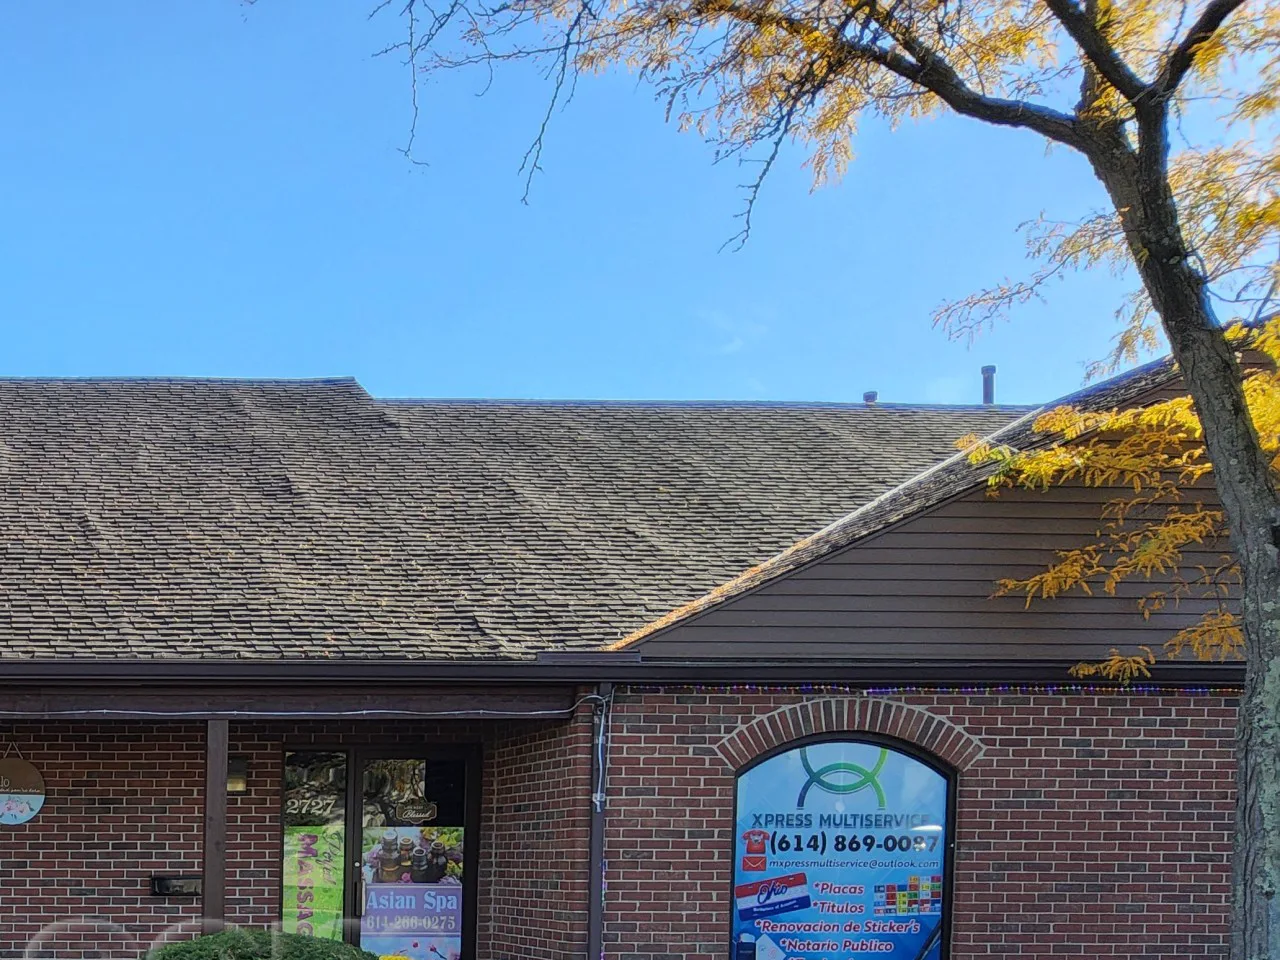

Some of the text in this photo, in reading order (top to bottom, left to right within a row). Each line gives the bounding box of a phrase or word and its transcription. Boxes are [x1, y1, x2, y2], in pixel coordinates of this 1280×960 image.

[286, 799, 335, 814] 2727
[752, 813, 813, 828] XPRESS
[770, 830, 939, 855] (614) 869-0087
[769, 858, 939, 870] mxpressmultiservice@outlook.com
[296, 833, 319, 936] MASSAG
[366, 890, 458, 912] Asian Spa
[366, 915, 456, 930] 614-266-0275
[844, 920, 861, 933] de
[863, 919, 920, 934] Sticker's
[842, 939, 893, 952] Publico
